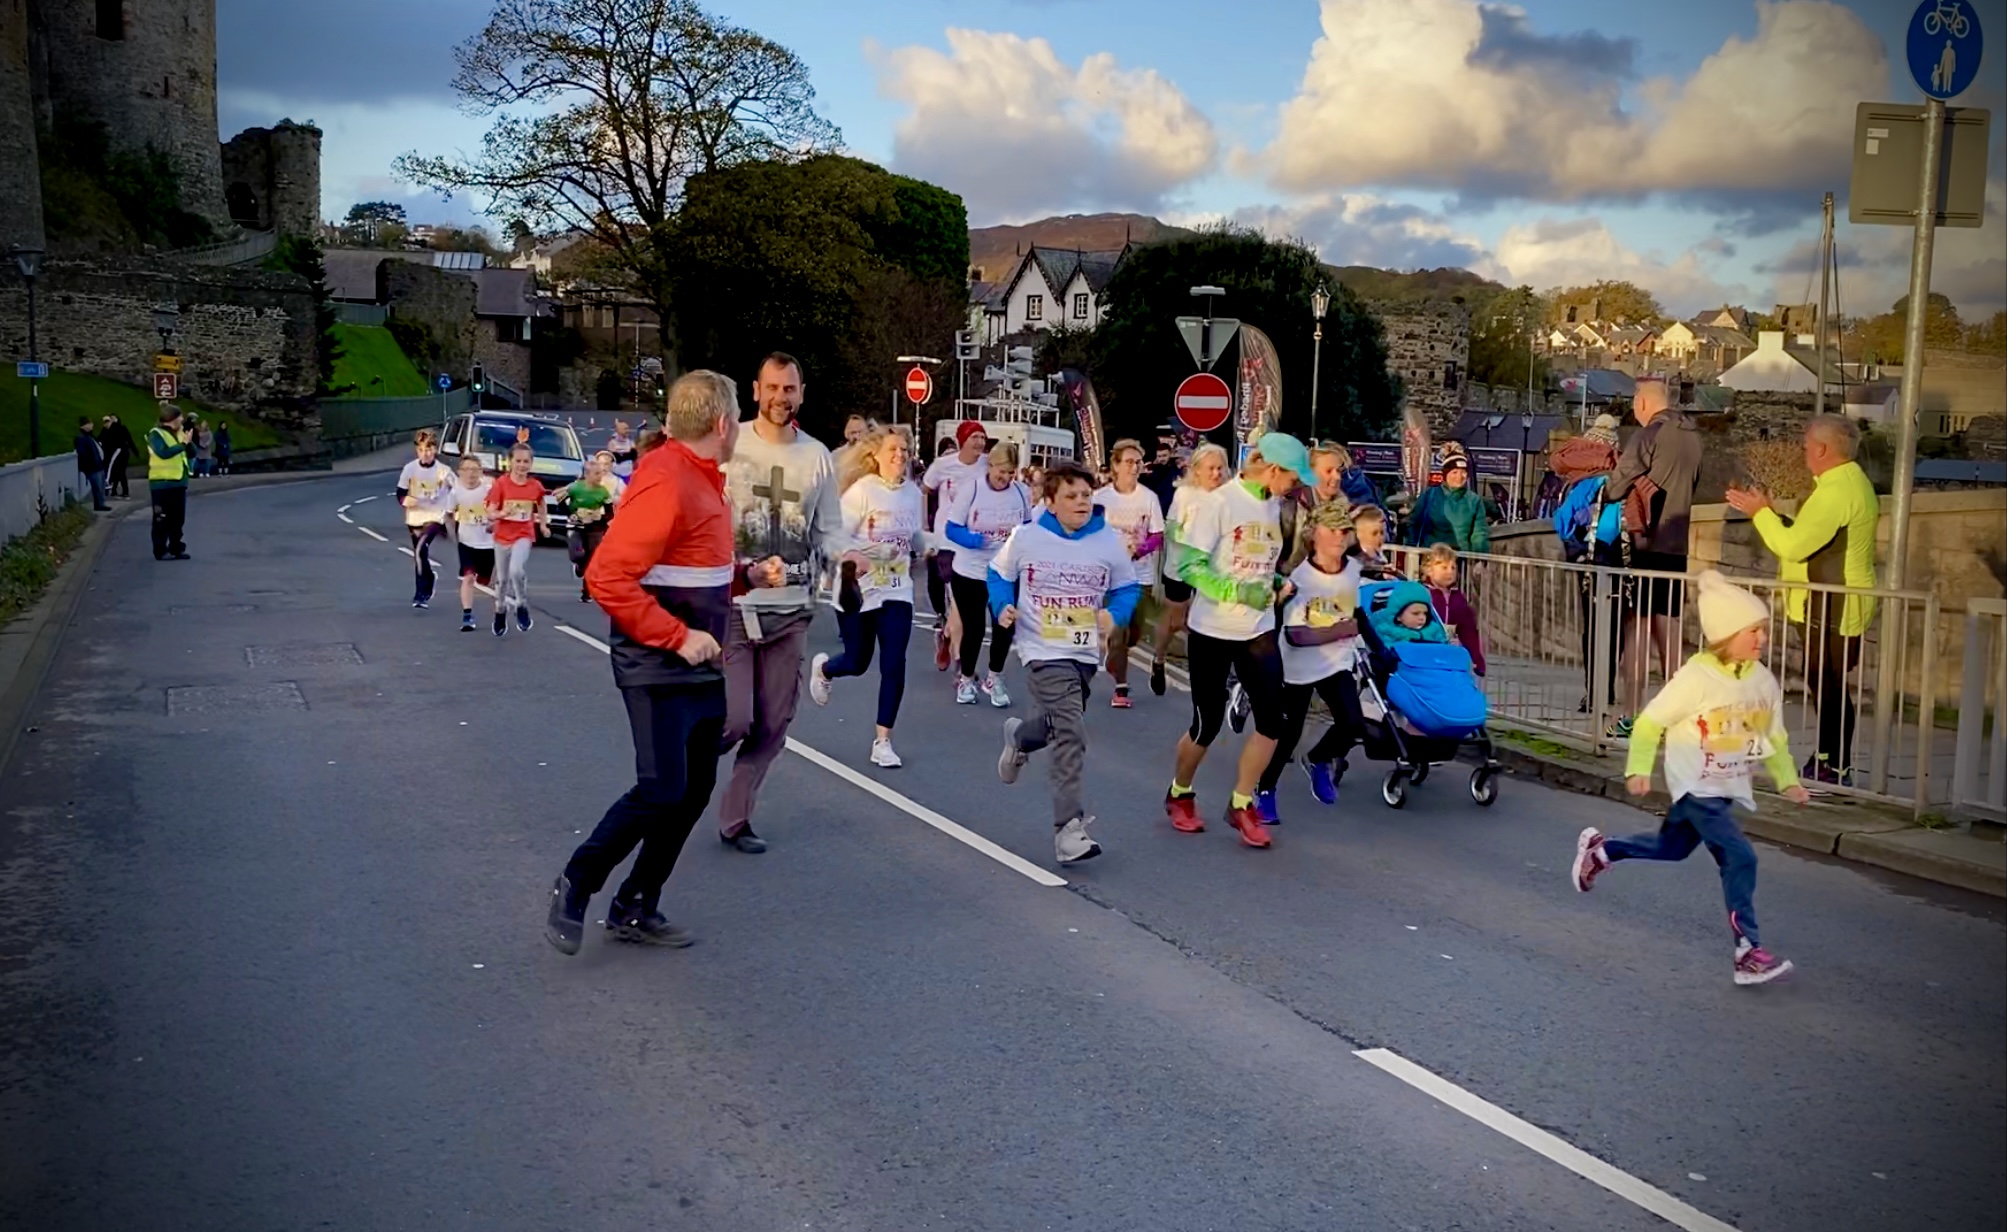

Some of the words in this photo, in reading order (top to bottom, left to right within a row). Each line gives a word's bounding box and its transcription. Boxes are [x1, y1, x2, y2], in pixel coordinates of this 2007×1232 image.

[1031, 594, 1062, 609] FUN
[1068, 595, 1098, 609] RUN
[1073, 631, 1090, 646] 32
